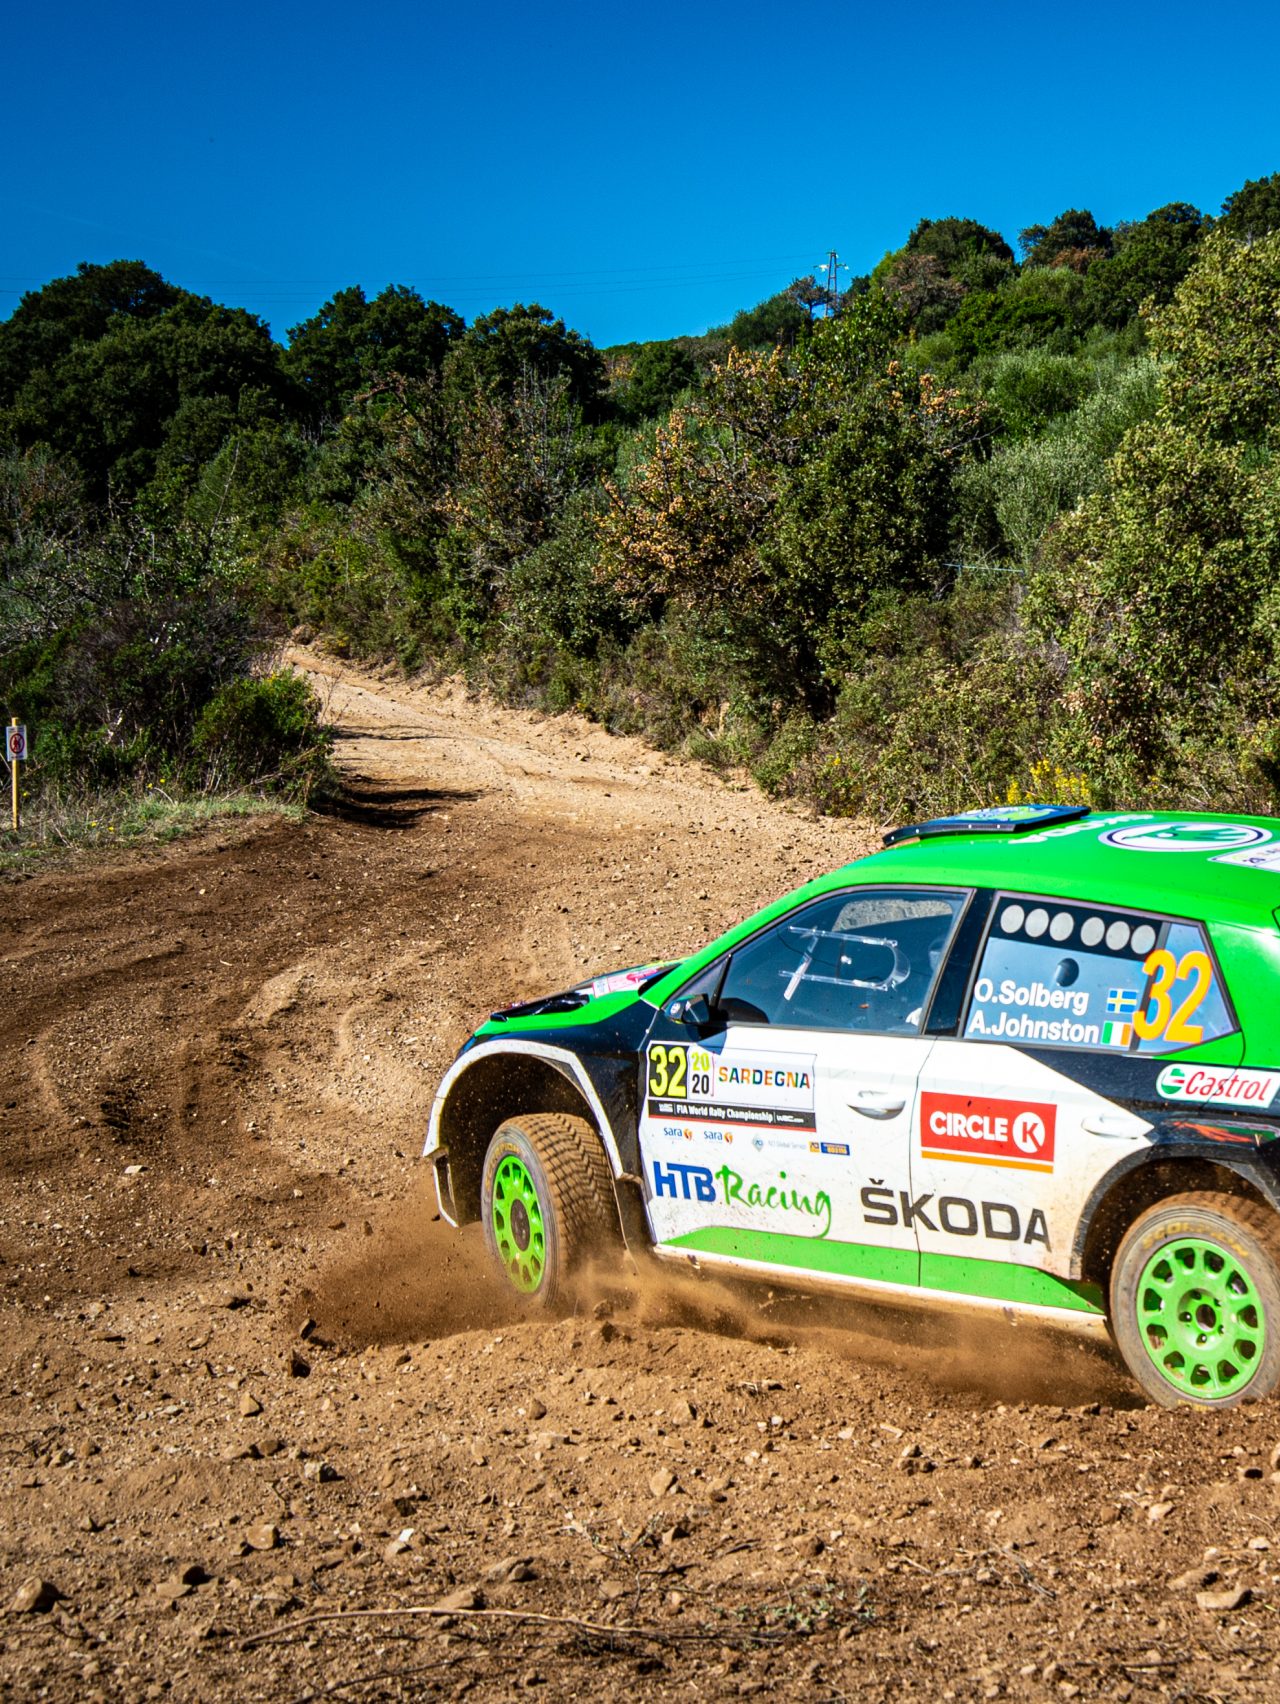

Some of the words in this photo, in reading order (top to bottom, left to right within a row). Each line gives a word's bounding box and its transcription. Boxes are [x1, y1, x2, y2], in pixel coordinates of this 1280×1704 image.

[974, 978, 1089, 1015] O.Solberg
[1132, 948, 1213, 1044] 32
[968, 1010, 1100, 1044] A.Johnston
[650, 1045, 687, 1097] 32
[691, 1052, 710, 1071] 20
[718, 1066, 811, 1089] SARDEGNA
[692, 1074, 710, 1095] 20
[1185, 1071, 1273, 1101] Castrol
[676, 1104, 688, 1115] FIA
[689, 1105, 708, 1116] World
[709, 1107, 725, 1119] Rally
[727, 1108, 773, 1123] Championship
[664, 1127, 683, 1137] sara
[704, 1130, 723, 1141] sara
[929, 1110, 1008, 1142] CIRCLE
[1020, 1120, 1045, 1150] K
[653, 1161, 716, 1202] HTB
[715, 1164, 832, 1239] Racing
[860, 1178, 1052, 1253] ŠKODA
